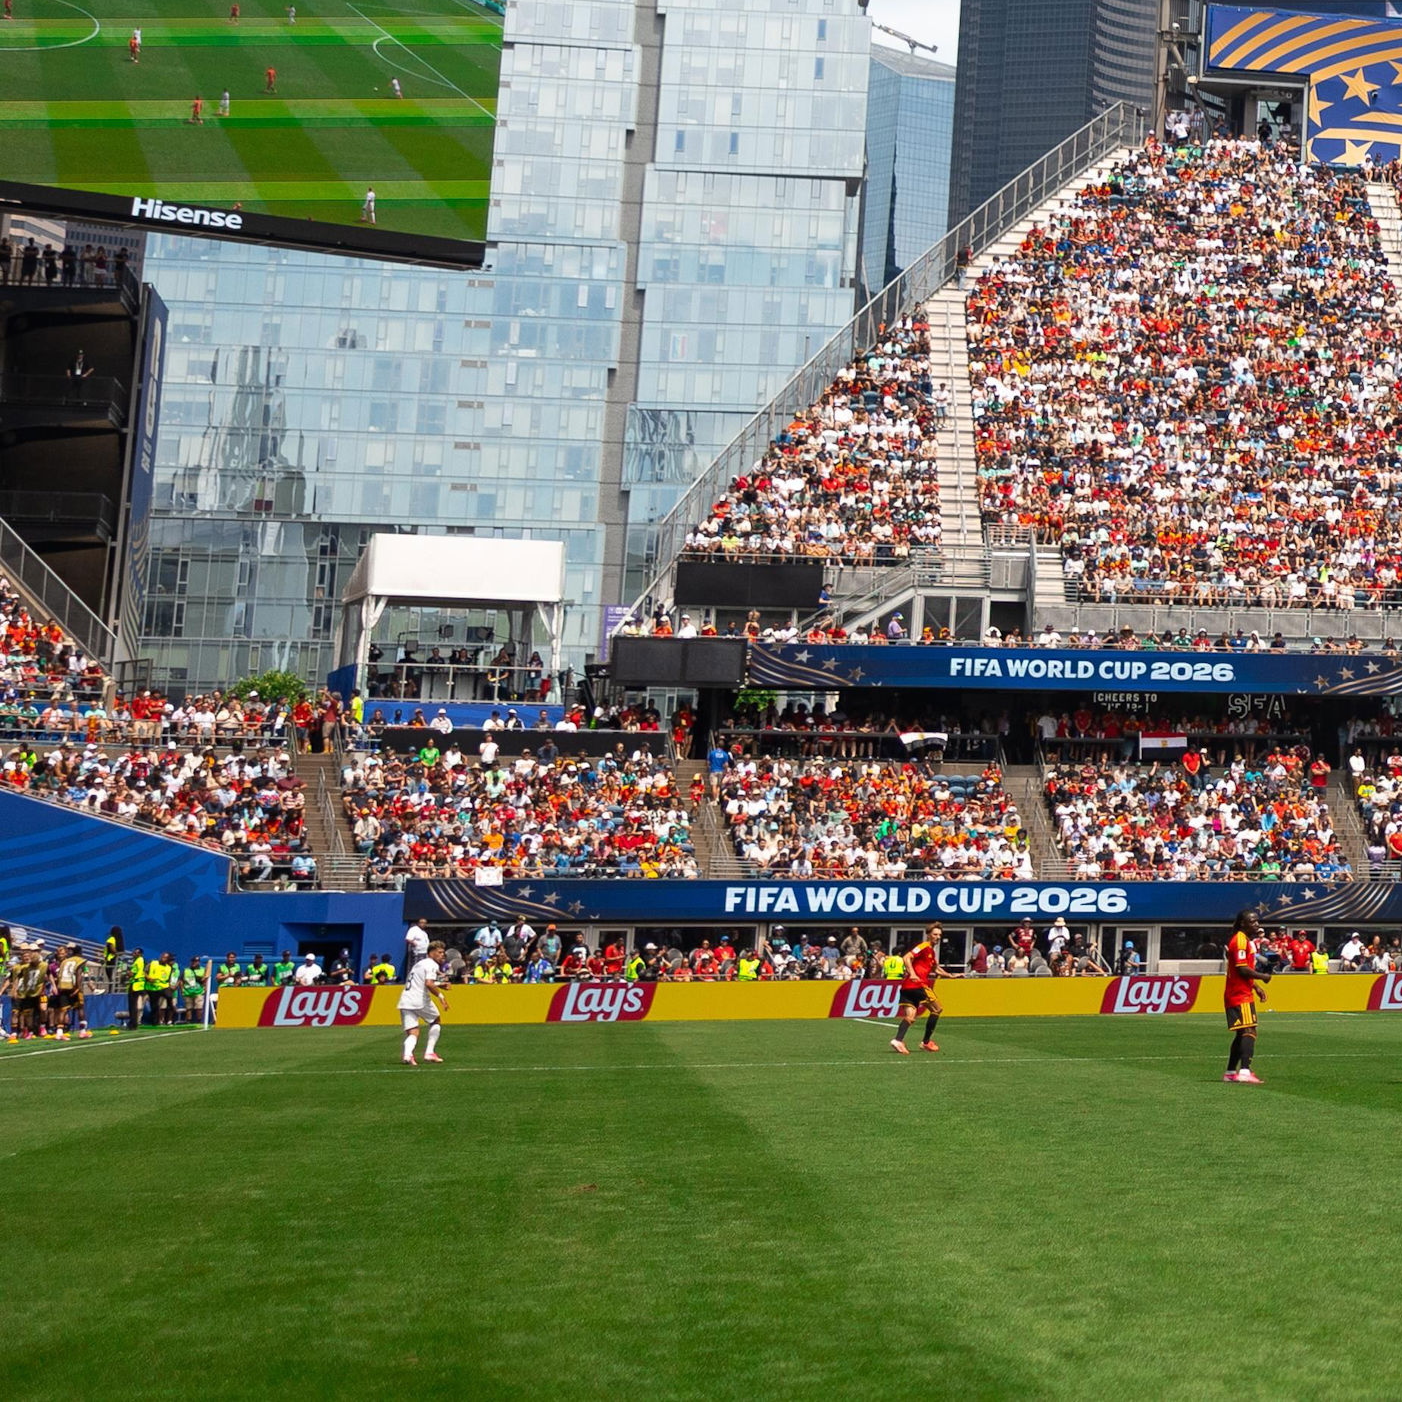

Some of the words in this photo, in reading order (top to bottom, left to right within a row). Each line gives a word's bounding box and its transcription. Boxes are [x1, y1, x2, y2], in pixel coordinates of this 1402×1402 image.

[131, 197, 243, 229] Hisense
[949, 658, 1004, 678] FIFA
[1006, 659, 1095, 679] WORLD
[1099, 661, 1147, 680] CUP
[1151, 662, 1234, 681] 2026
[1145, 693, 1158, 702] TO
[725, 886, 800, 913] FIFA
[806, 886, 930, 913] WORLD
[936, 886, 1004, 913] CUP
[1010, 886, 1128, 913] 2026
[273, 985, 362, 1026] Lay's
[560, 982, 645, 1021] Lay's
[843, 979, 902, 1018] Lay
[1114, 975, 1190, 1014] Lay's
